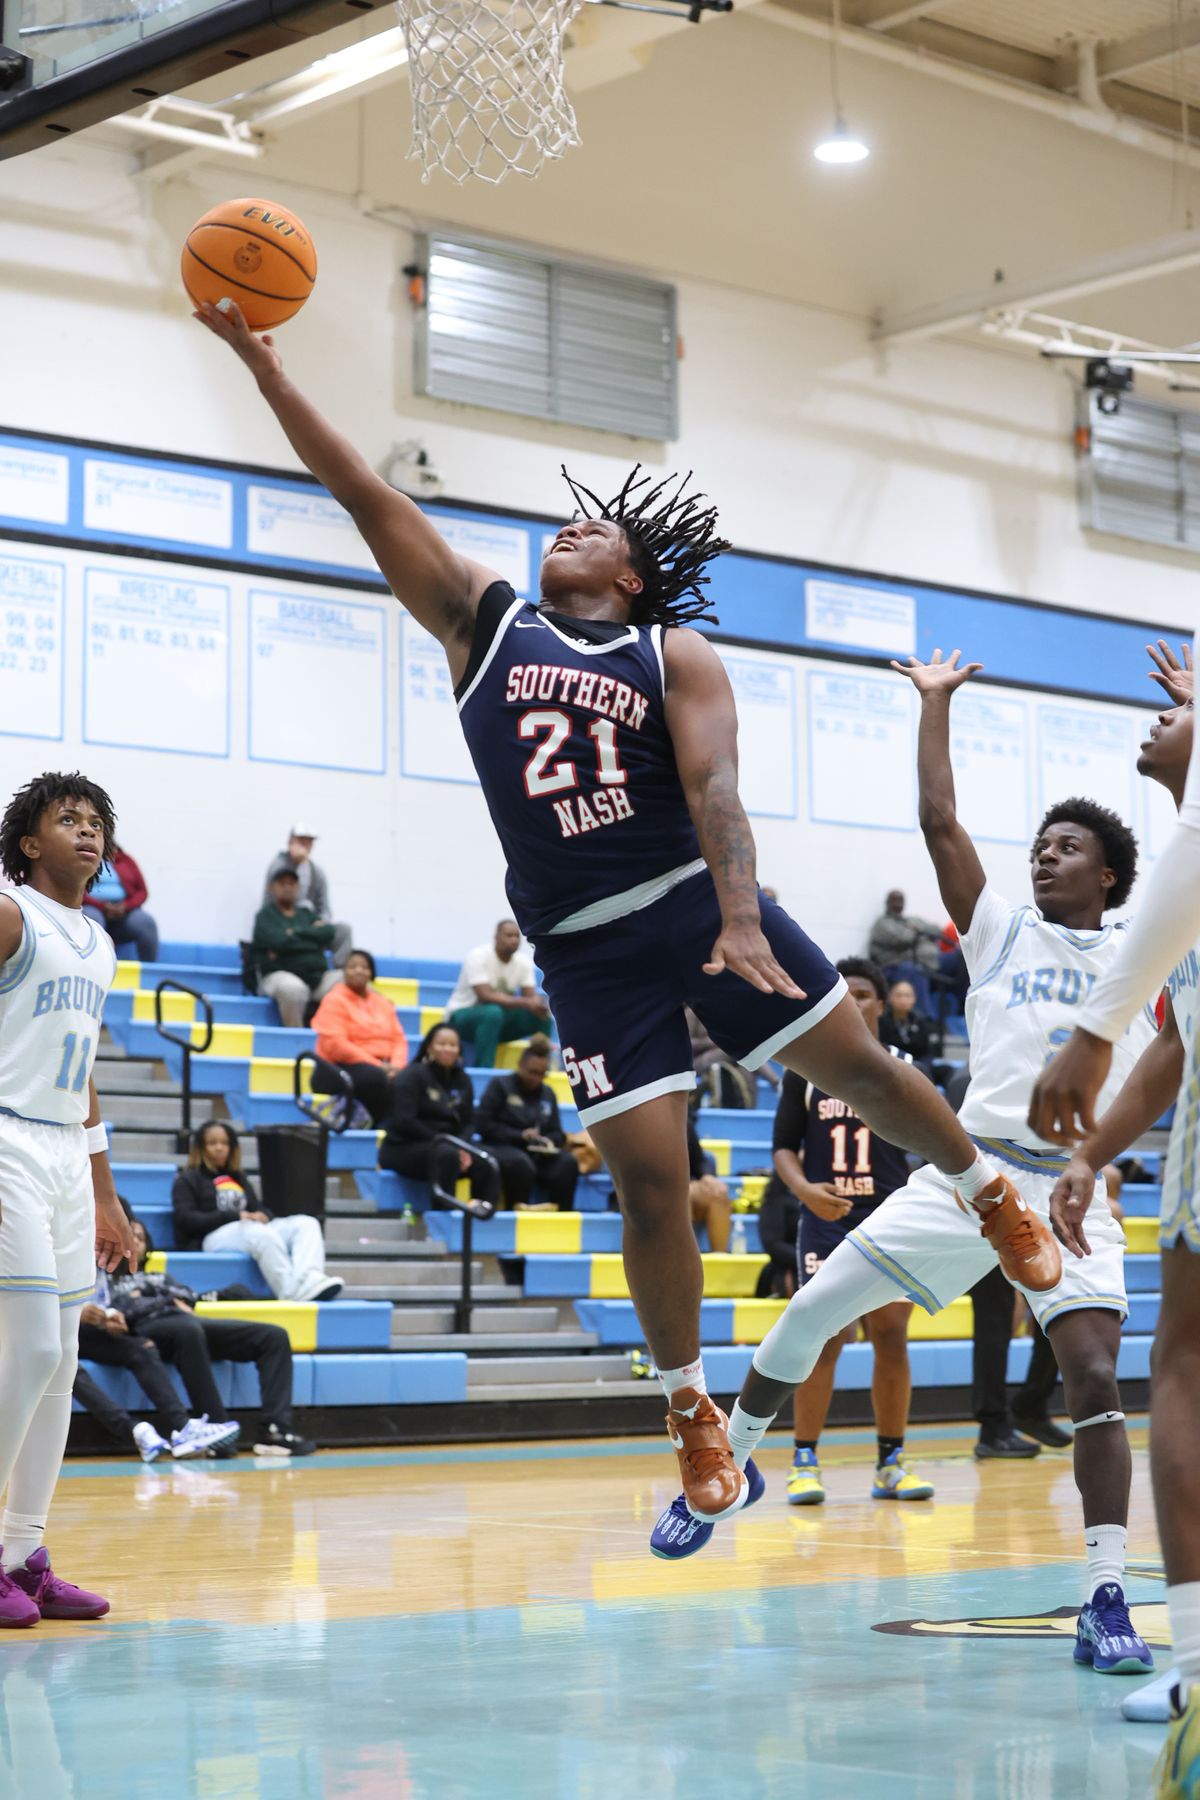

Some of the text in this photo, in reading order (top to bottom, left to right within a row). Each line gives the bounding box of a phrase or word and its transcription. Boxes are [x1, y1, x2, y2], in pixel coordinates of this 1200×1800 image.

[506, 664, 649, 731] SOUTHERN
[517, 707, 628, 800] 21
[552, 786, 636, 838] NASH
[54, 1030, 92, 1095] 11
[562, 1046, 614, 1099] SN
[830, 1123, 871, 1173] 11
[834, 1177, 875, 1197] NASH
